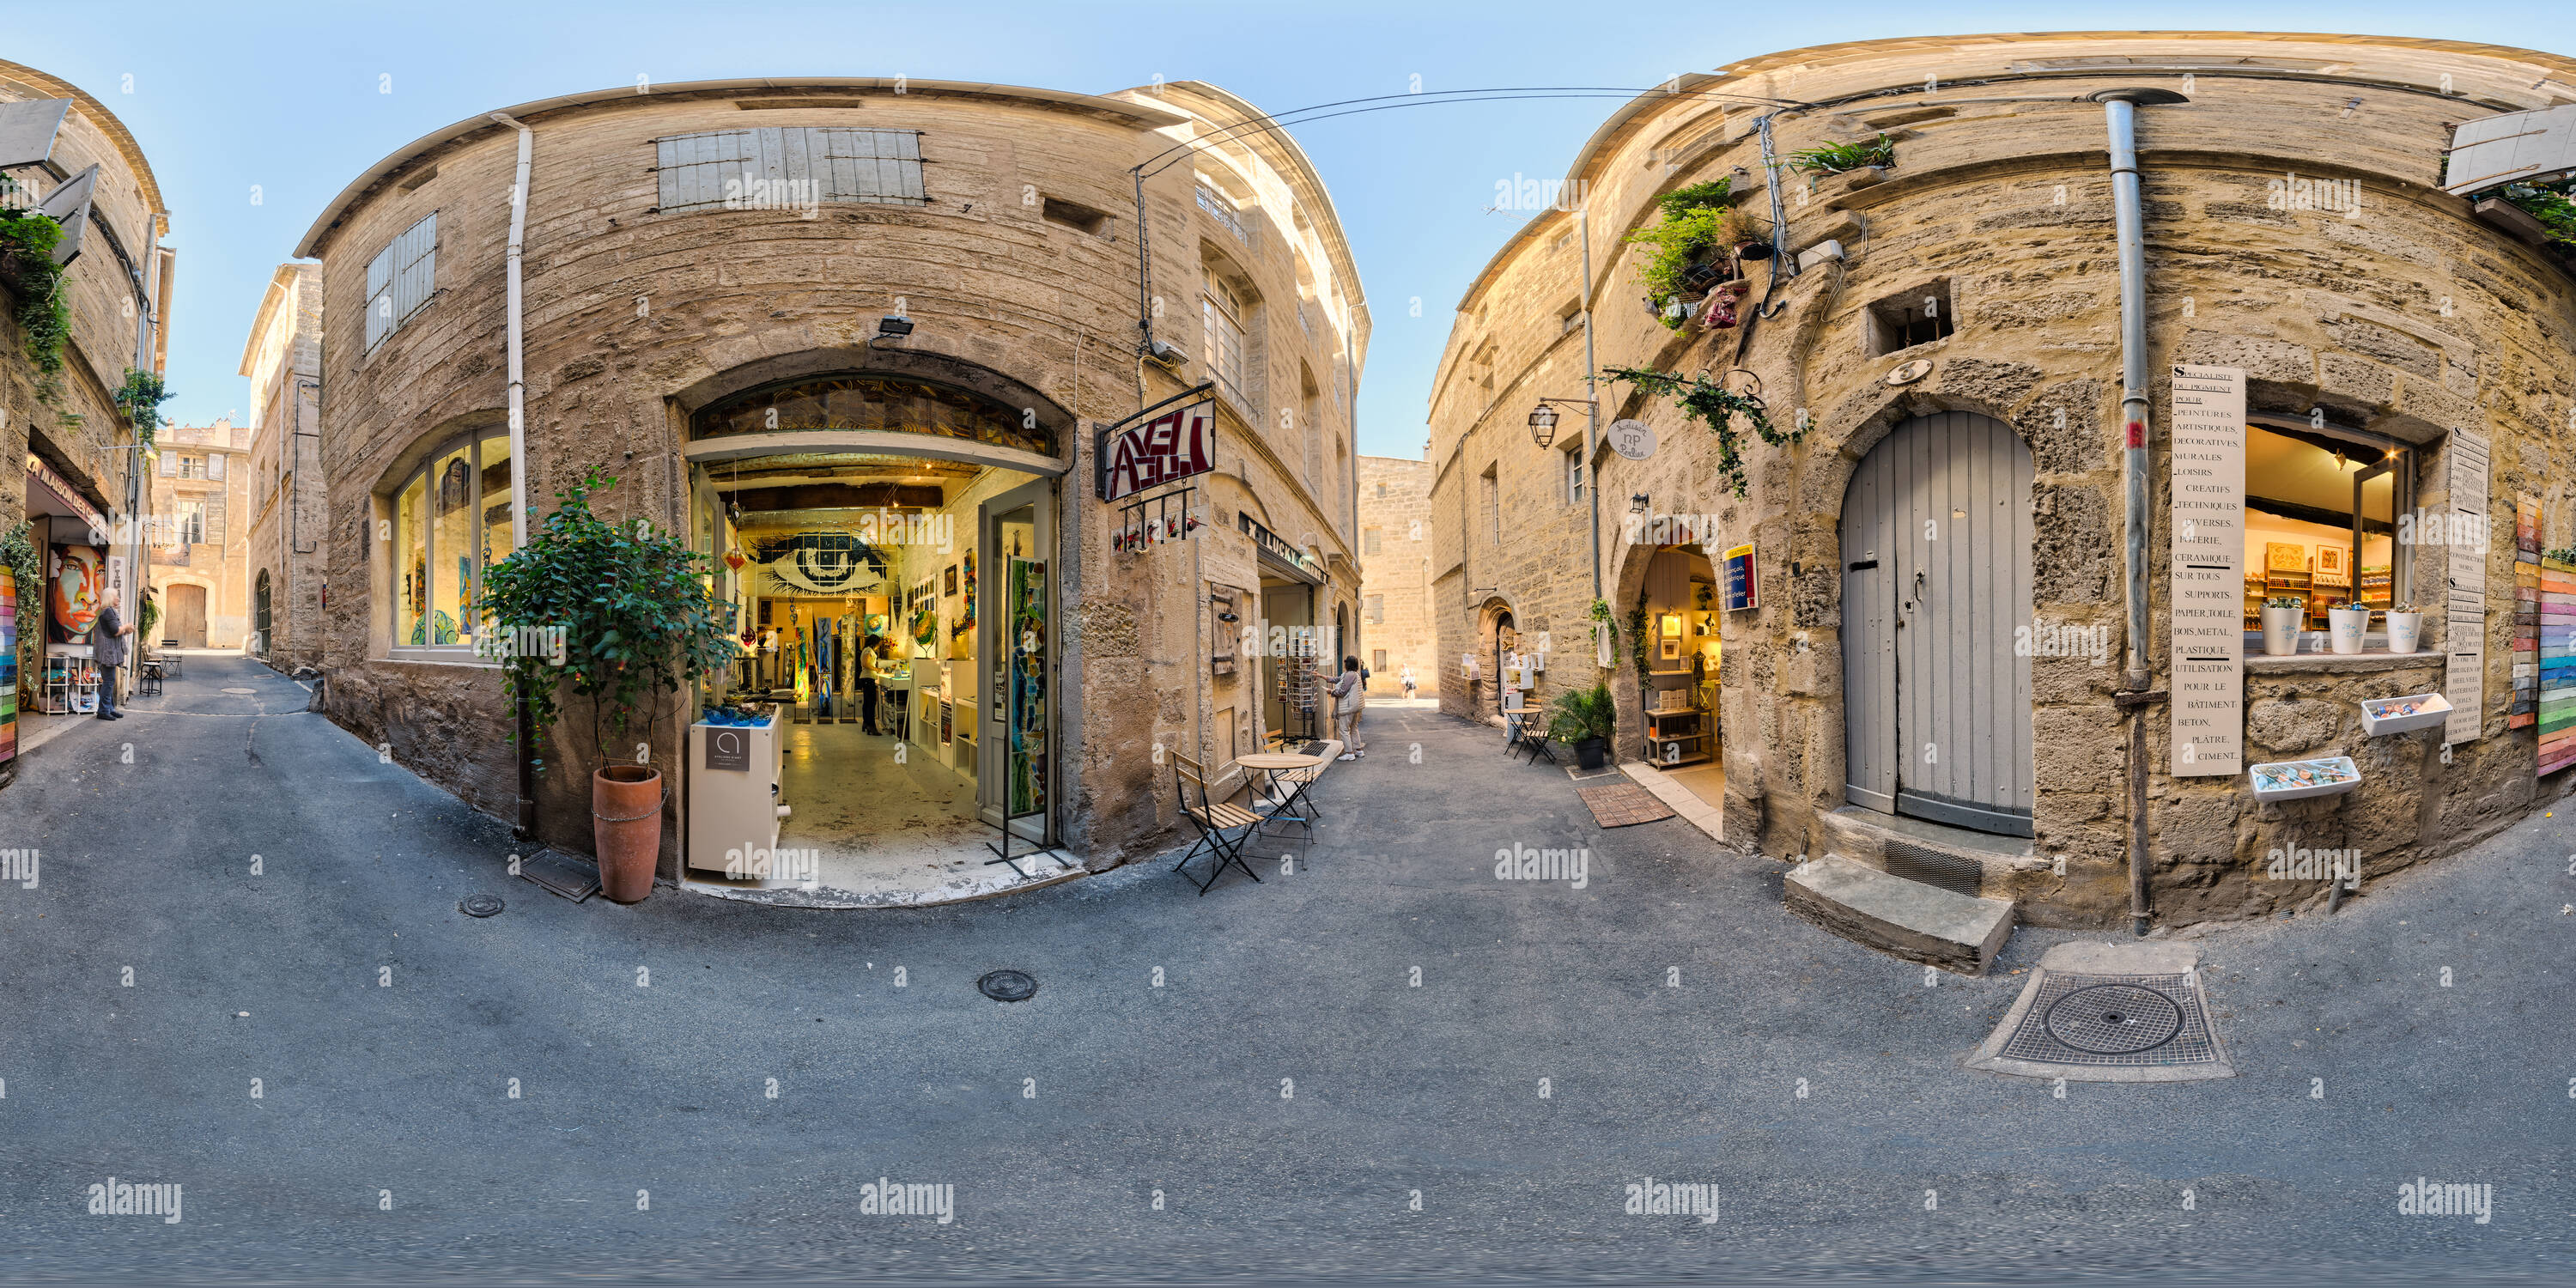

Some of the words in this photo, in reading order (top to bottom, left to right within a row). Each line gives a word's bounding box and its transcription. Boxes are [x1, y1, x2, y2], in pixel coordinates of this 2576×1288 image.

[2173, 367, 2233, 380] SPECIALISTE
[2191, 384, 2232, 392] PIGMENT
[2174, 453, 2222, 461] MURALES
[39, 468, 73, 504] MAISON
[72, 495, 86, 515] DES
[2185, 484, 2231, 494] CREATIFS
[1266, 532, 1296, 564] LUCKY
[2175, 571, 2193, 580] SUR
[2197, 572, 2221, 581] TOUS
[2175, 665, 2233, 673] UTILISATION
[2184, 683, 2209, 691] POUR
[2215, 683, 2227, 691] LE
[2178, 718, 2211, 727] BETON,
